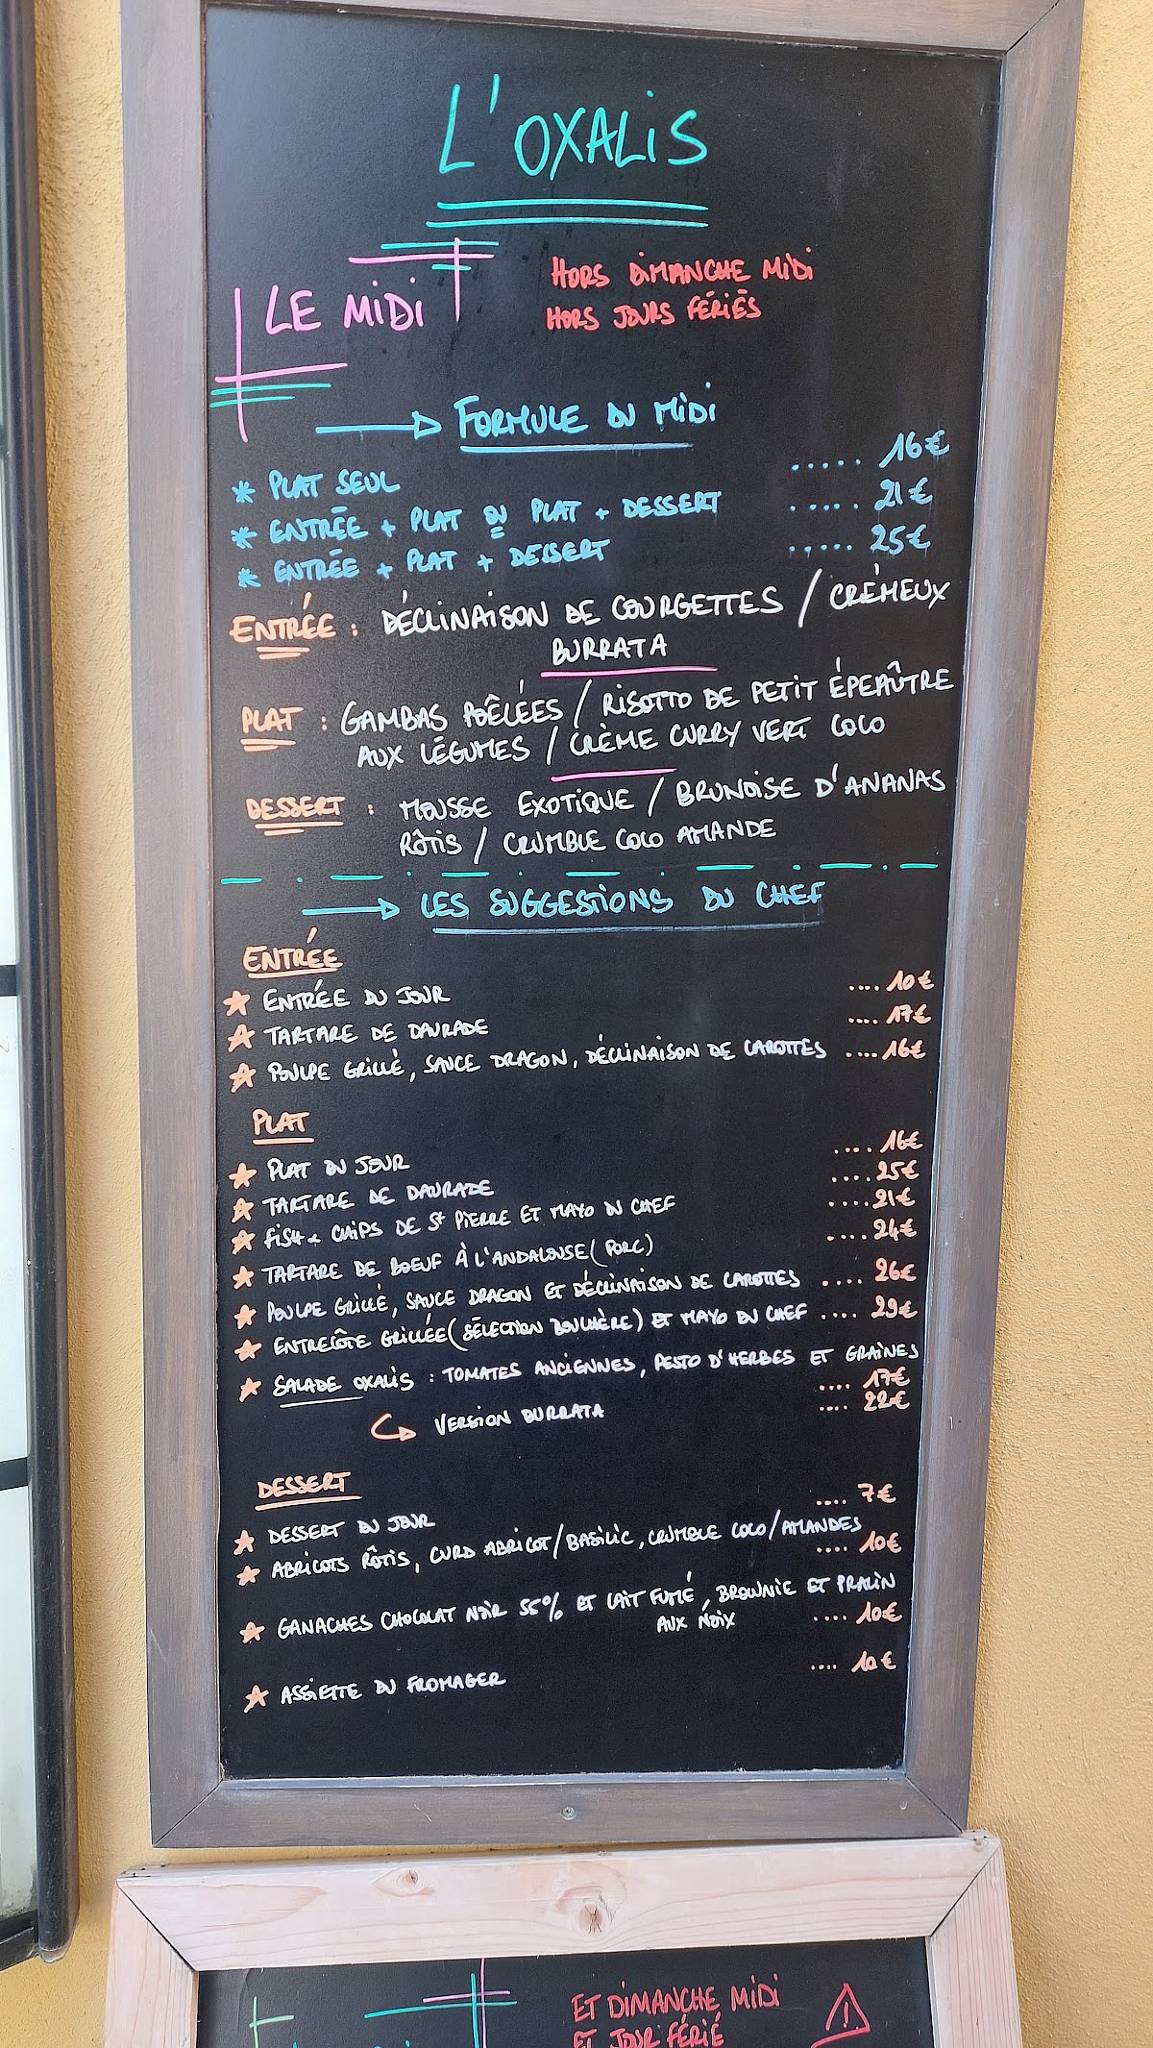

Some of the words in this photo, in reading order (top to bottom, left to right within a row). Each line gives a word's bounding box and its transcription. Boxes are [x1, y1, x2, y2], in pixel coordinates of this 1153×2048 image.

[552, 256, 610, 288] HORS
[265, 286, 322, 334] LE
[546, 306, 600, 330] HORS
[613, 301, 675, 329] JOURS
[453, 395, 589, 439] FORMULE
[607, 401, 636, 428] DU
[268, 469, 323, 500] PLAT
[335, 469, 401, 494] SEUL
[410, 506, 462, 533] PLAT
[483, 504, 507, 524] OU
[531, 498, 581, 524] PLAT
[622, 491, 722, 518] DESSERT
[407, 548, 458, 573] PLAT
[509, 539, 610, 568] DESSERT
[565, 600, 600, 625] DE
[611, 586, 784, 621] COURGETTES
[553, 632, 668, 665] BURRATA
[242, 706, 304, 734] PLAT
[340, 700, 448, 736] GAMBAS
[704, 687, 740, 710] DE
[357, 745, 404, 770] AUX
[669, 720, 743, 747] CURRY
[752, 716, 812, 743] VERT
[830, 715, 885, 739] COCO
[246, 796, 345, 820] DESSERT
[399, 796, 492, 822] MOUSSE
[503, 828, 606, 856] CRUMBLE
[615, 828, 664, 851] COCO
[676, 818, 777, 846] AMANDE
[421, 891, 470, 919] LES
[700, 885, 735, 913] DU
[756, 880, 826, 908] CHEF
[364, 988, 388, 1006] DU
[396, 985, 451, 1006] JOUR
[264, 1023, 358, 1047] TARTARE
[371, 1023, 398, 1043] DE
[407, 1018, 489, 1039] DAURADE
[268, 1061, 331, 1083] POULPE
[424, 1053, 481, 1075] SAUCE
[707, 1041, 736, 1061] DE
[744, 1037, 828, 1059] CAROTTES
[252, 1109, 310, 1135] PLAT
[267, 1157, 312, 1182] PLAT
[324, 1158, 347, 1175] DU
[354, 1153, 411, 1175] JOUR
[261, 1191, 356, 1217] TARTARE
[369, 1186, 396, 1206] DE
[406, 1179, 495, 1202] DAURADE
[395, 1217, 421, 1236] DE
[520, 1205, 541, 1224] ET
[550, 1203, 594, 1220] MAYO
[604, 1200, 623, 1216] DU
[630, 1195, 676, 1215] CHEF
[261, 1263, 343, 1287] TARTARE
[354, 1260, 381, 1278] DE
[267, 1301, 327, 1323] POULPE
[406, 1290, 456, 1311] SAUCE
[469, 1285, 532, 1305] DRAGON
[544, 1281, 566, 1300] ET
[691, 1274, 713, 1289] DE
[723, 1269, 801, 1289] CAROTTES
[651, 1312, 673, 1328] ET
[680, 1309, 728, 1325] MAYO
[736, 1308, 758, 1324] DU
[766, 1303, 808, 1321] CHEF
[272, 1375, 341, 1396] SALADE
[442, 1361, 523, 1384] TOMATES
[654, 1353, 701, 1371] PESTO
[810, 1349, 834, 1365] ET
[521, 1404, 605, 1424] BURRATA
[257, 1471, 351, 1499] DESSERT
[269, 1521, 345, 1545] DESSERT
[357, 1519, 380, 1536] DU
[388, 1513, 436, 1533] JOUR
[429, 1546, 476, 1564] CURD
[648, 1524, 722, 1546] CRUMBLE
[277, 1616, 373, 1640] GANACHES
[381, 1607, 456, 1629] CHOCOLAT
[519, 1591, 563, 1622] 55%
[576, 1594, 597, 1612] ET
[807, 1576, 831, 1593] ET
[657, 1615, 687, 1633] AUX
[375, 1679, 397, 1695] DU
[406, 1671, 506, 1693] FROMAGER
[571, 1993, 601, 2022] ET
